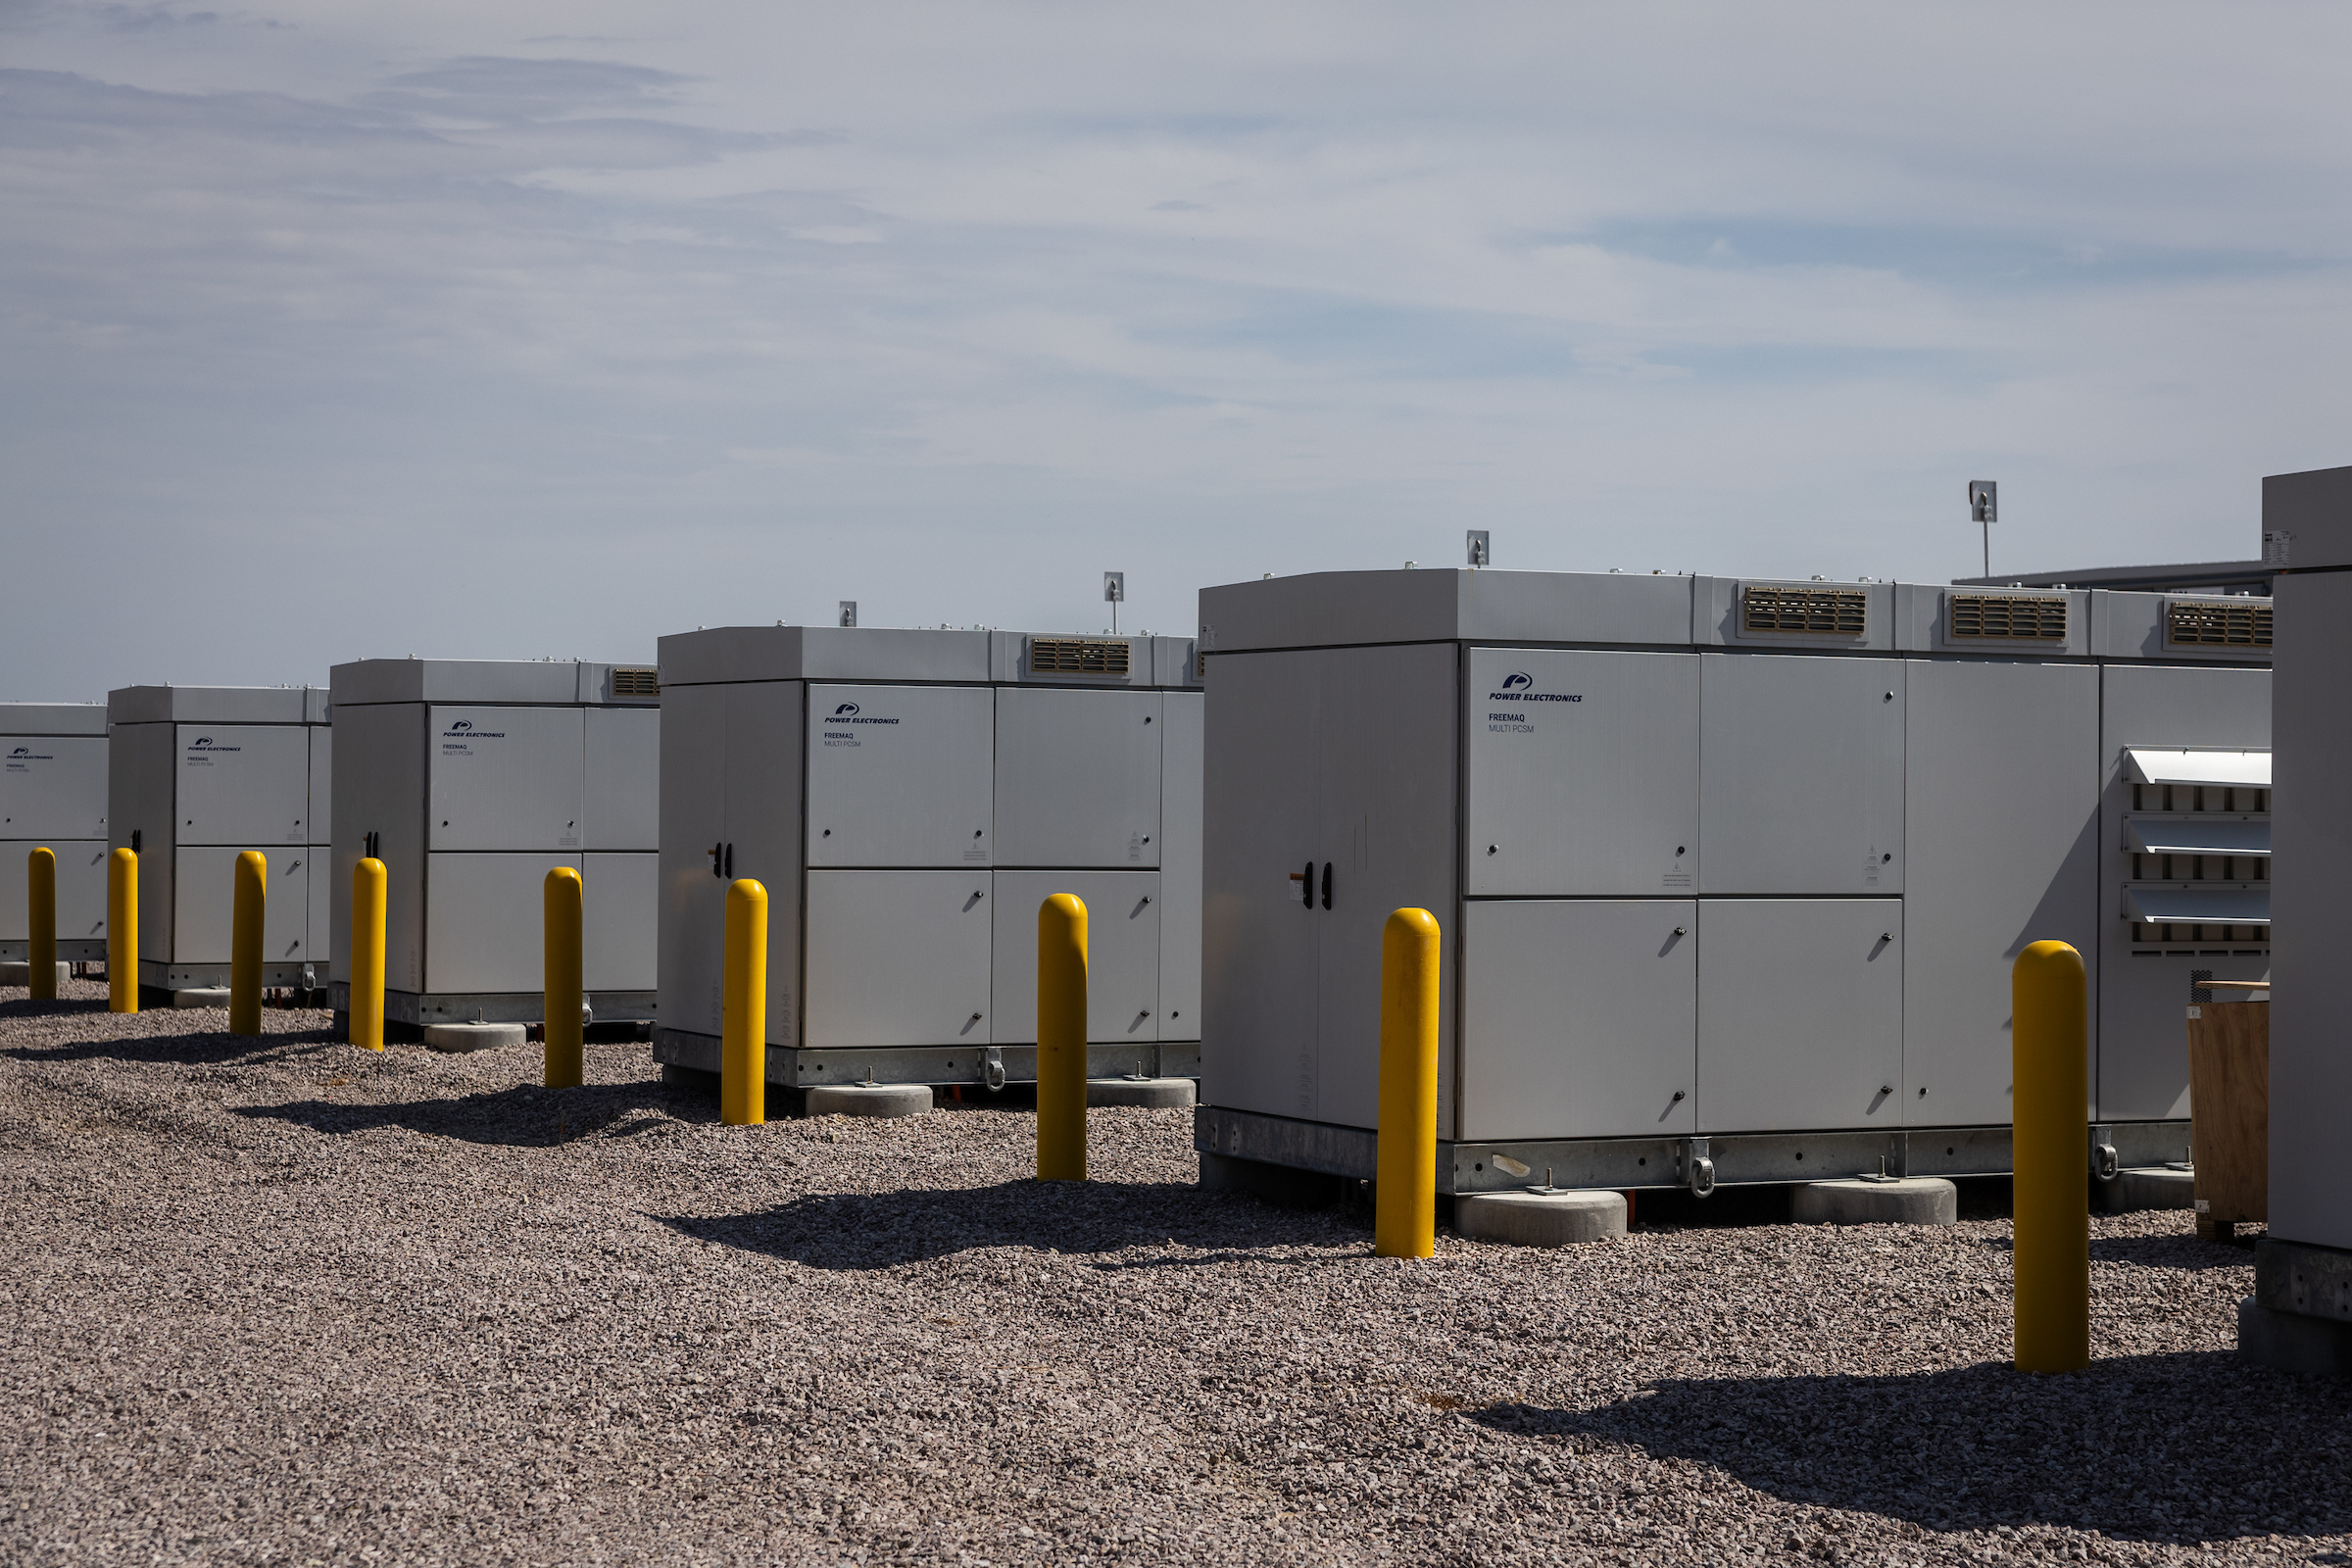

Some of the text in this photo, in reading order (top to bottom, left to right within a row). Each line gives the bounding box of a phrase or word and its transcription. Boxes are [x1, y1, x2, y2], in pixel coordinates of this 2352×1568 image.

[1489, 692, 1583, 703] POWER ELECTRONICS
[1489, 713, 1525, 722] FREEMAQ
[1489, 724, 1535, 733] MULTI PCSM
